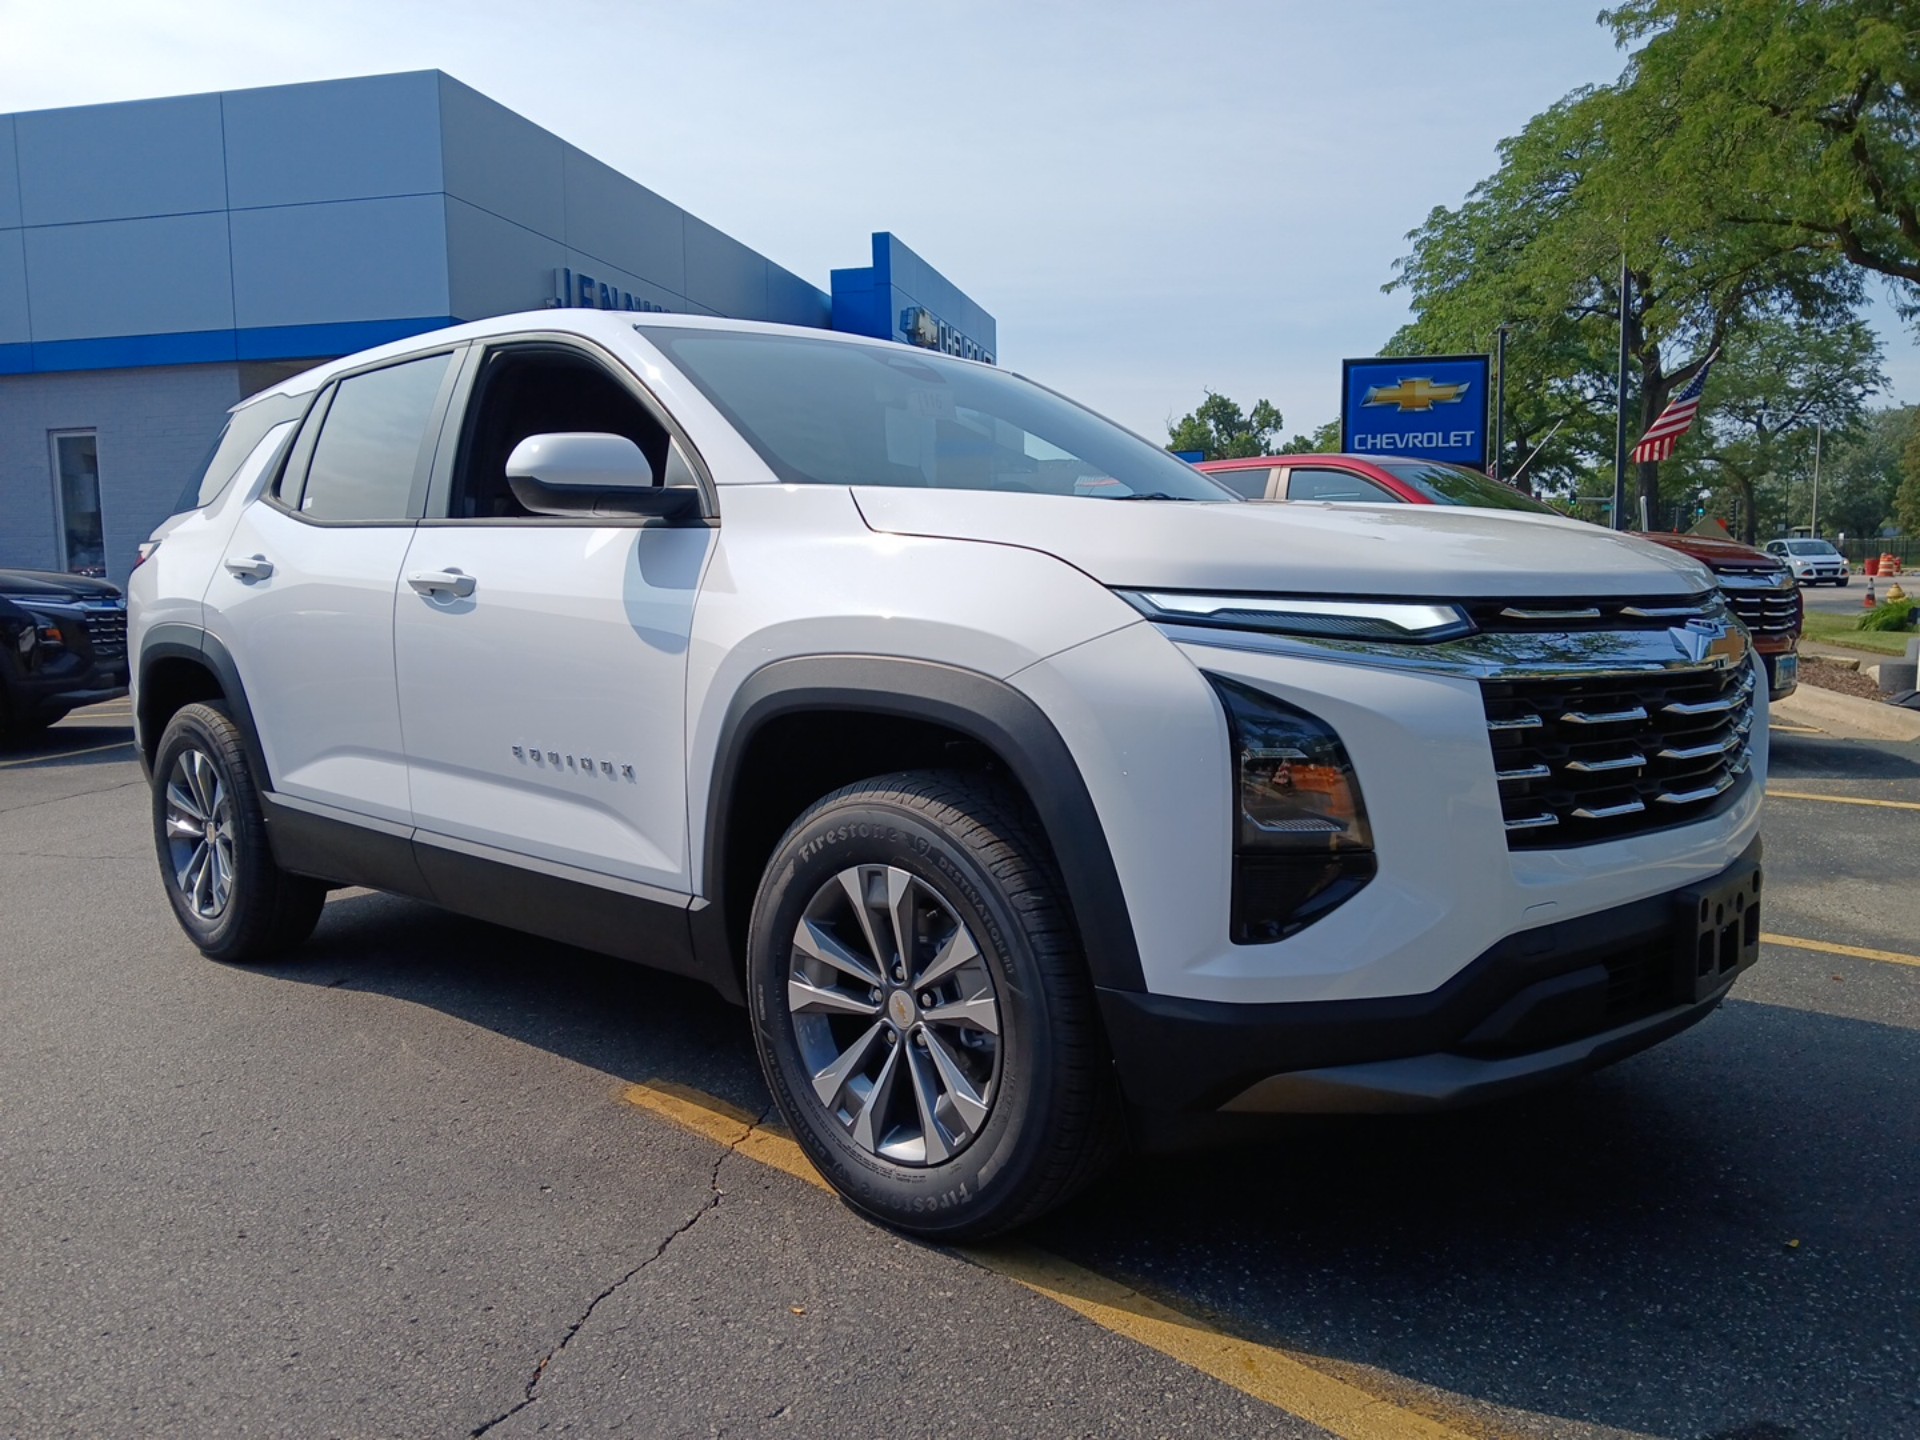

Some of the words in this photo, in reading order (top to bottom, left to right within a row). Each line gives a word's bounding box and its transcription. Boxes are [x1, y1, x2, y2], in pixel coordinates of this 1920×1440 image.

[1354, 431, 1475, 450] CHEVROLET
[512, 744, 633, 779] EQUINOX
[938, 856, 1007, 954] DESTINATION
